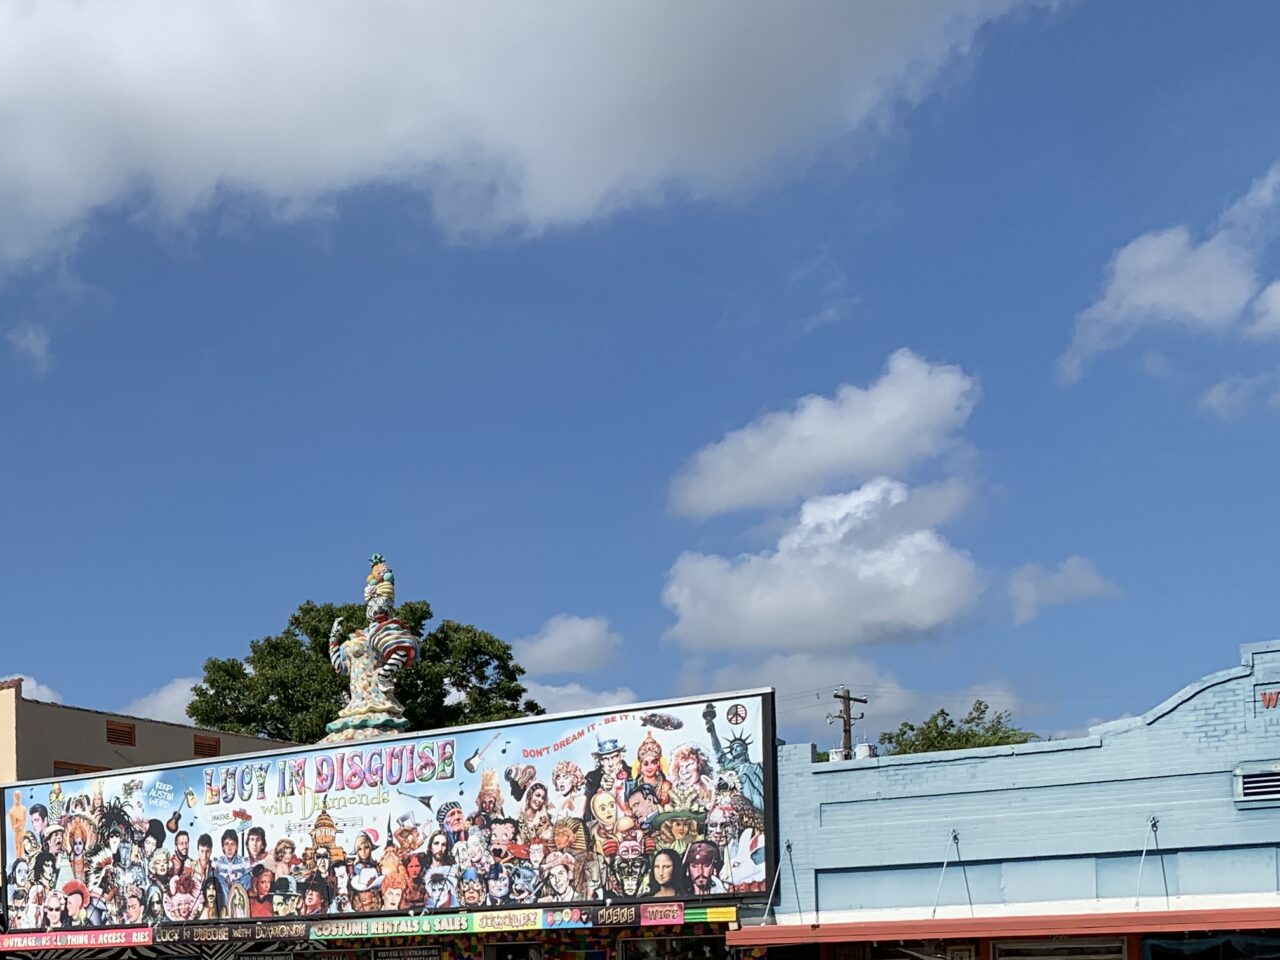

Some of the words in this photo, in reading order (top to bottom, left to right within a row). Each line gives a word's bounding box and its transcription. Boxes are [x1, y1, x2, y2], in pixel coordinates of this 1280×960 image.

[522, 745, 551, 758] DON'T
[553, 729, 586, 752] DREAM
[587, 722, 597, 733] IT
[604, 715, 618, 725] BE
[203, 761, 271, 806] LUCY
[277, 755, 308, 797] IN
[314, 739, 456, 794] DISGUISE
[149, 787, 174, 800] AUSTIN
[155, 780, 174, 791] KEEP
[260, 790, 293, 815] with
[299, 779, 390, 820] Diamonds
[479, 912, 538, 930] JEWELRY
[598, 907, 635, 924] MASKS
[647, 908, 679, 921] WIGS
[156, 926, 180, 942] LUCY
[255, 924, 306, 939] DIAMONDS
[315, 921, 369, 937] COSTUME
[370, 919, 421, 935] RENTALS
[422, 918, 431, 933] &
[433, 916, 469, 932] SALES
[53, 934, 89, 946] CLOTHING
[97, 931, 150, 944] ACCESSRIES
